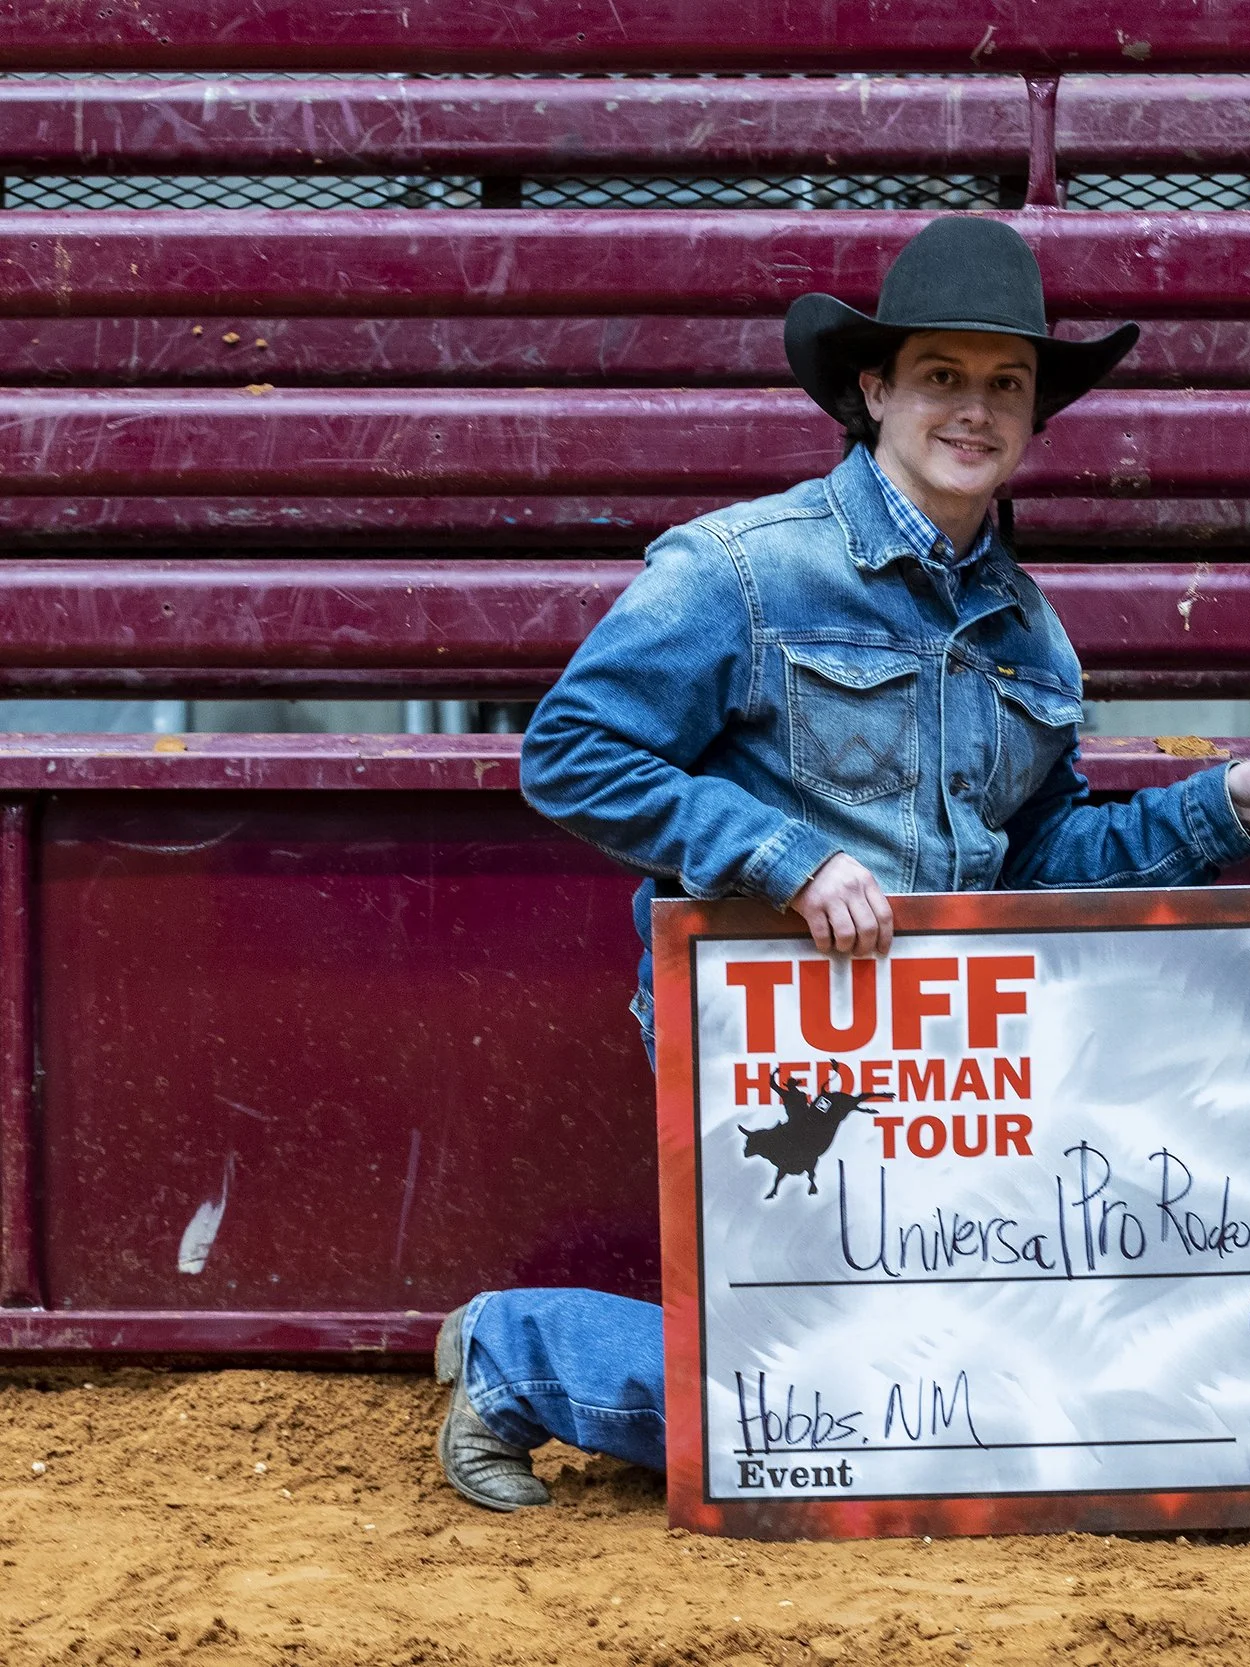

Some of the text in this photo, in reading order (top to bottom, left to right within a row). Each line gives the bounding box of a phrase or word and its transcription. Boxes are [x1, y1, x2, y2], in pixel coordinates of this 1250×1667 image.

[726, 956, 1035, 1053] TUFF
[734, 1056, 1033, 1106] HEDEMAN
[874, 1113, 1034, 1159] TOUR
[885, 1369, 990, 1450] NM
[737, 1458, 853, 1489] Event
